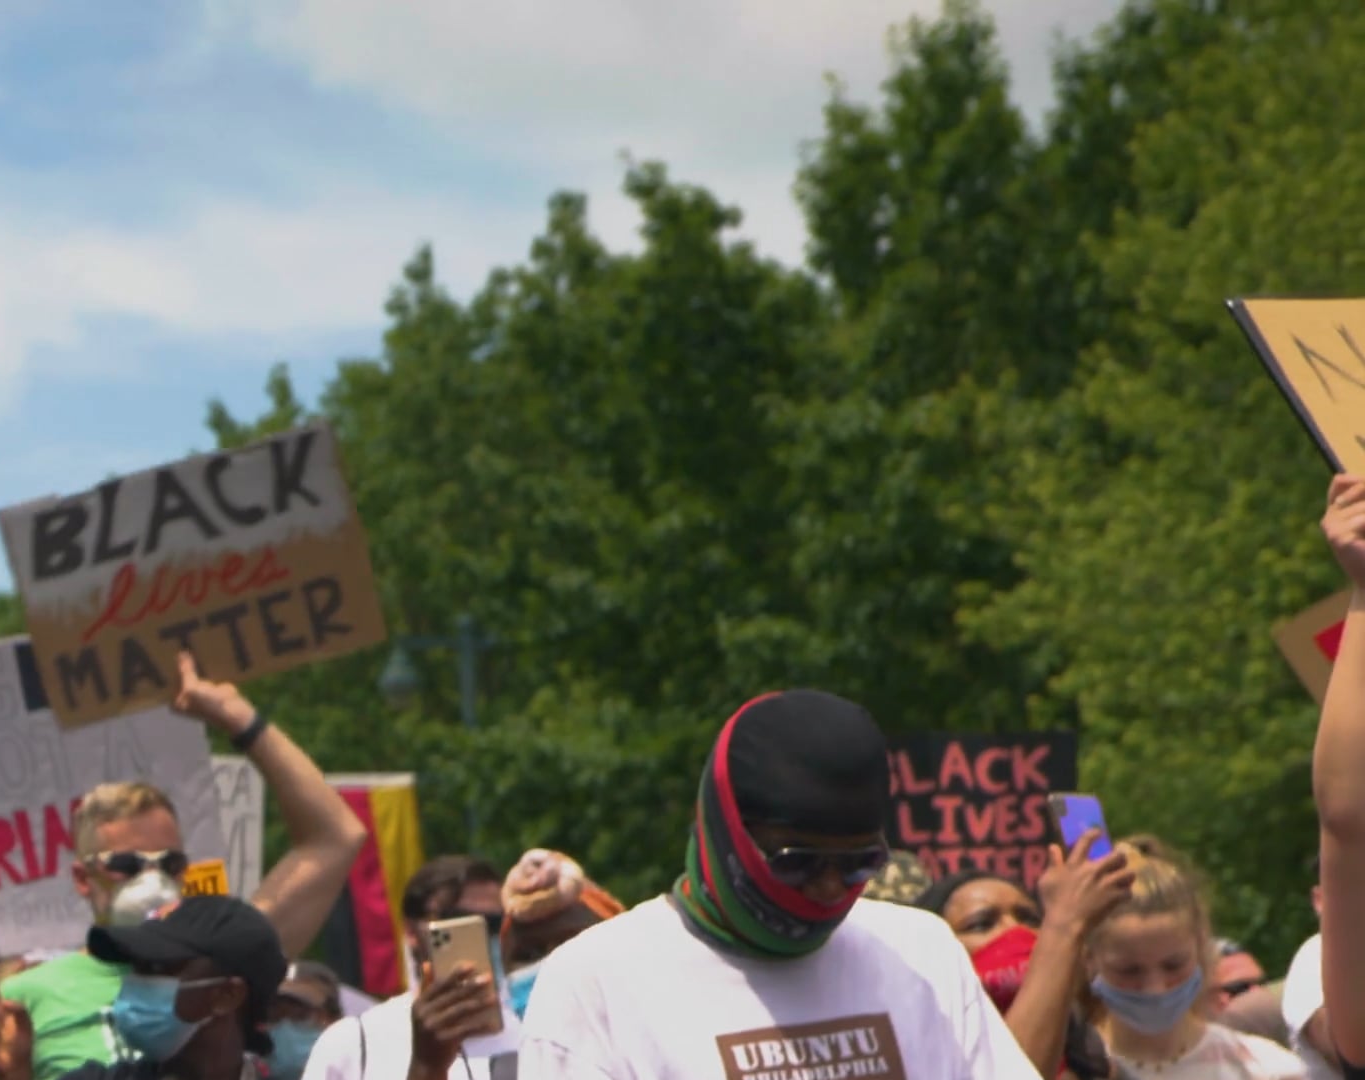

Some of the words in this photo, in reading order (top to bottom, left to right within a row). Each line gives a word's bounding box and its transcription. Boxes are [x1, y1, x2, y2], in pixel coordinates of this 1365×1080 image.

[33, 431, 322, 582] BLACK
[82, 545, 291, 643] lives
[54, 575, 355, 711] MATTER
[886, 741, 1050, 796] LACK
[898, 794, 1047, 845] LIVES
[731, 1026, 879, 1073] UBUNTU
